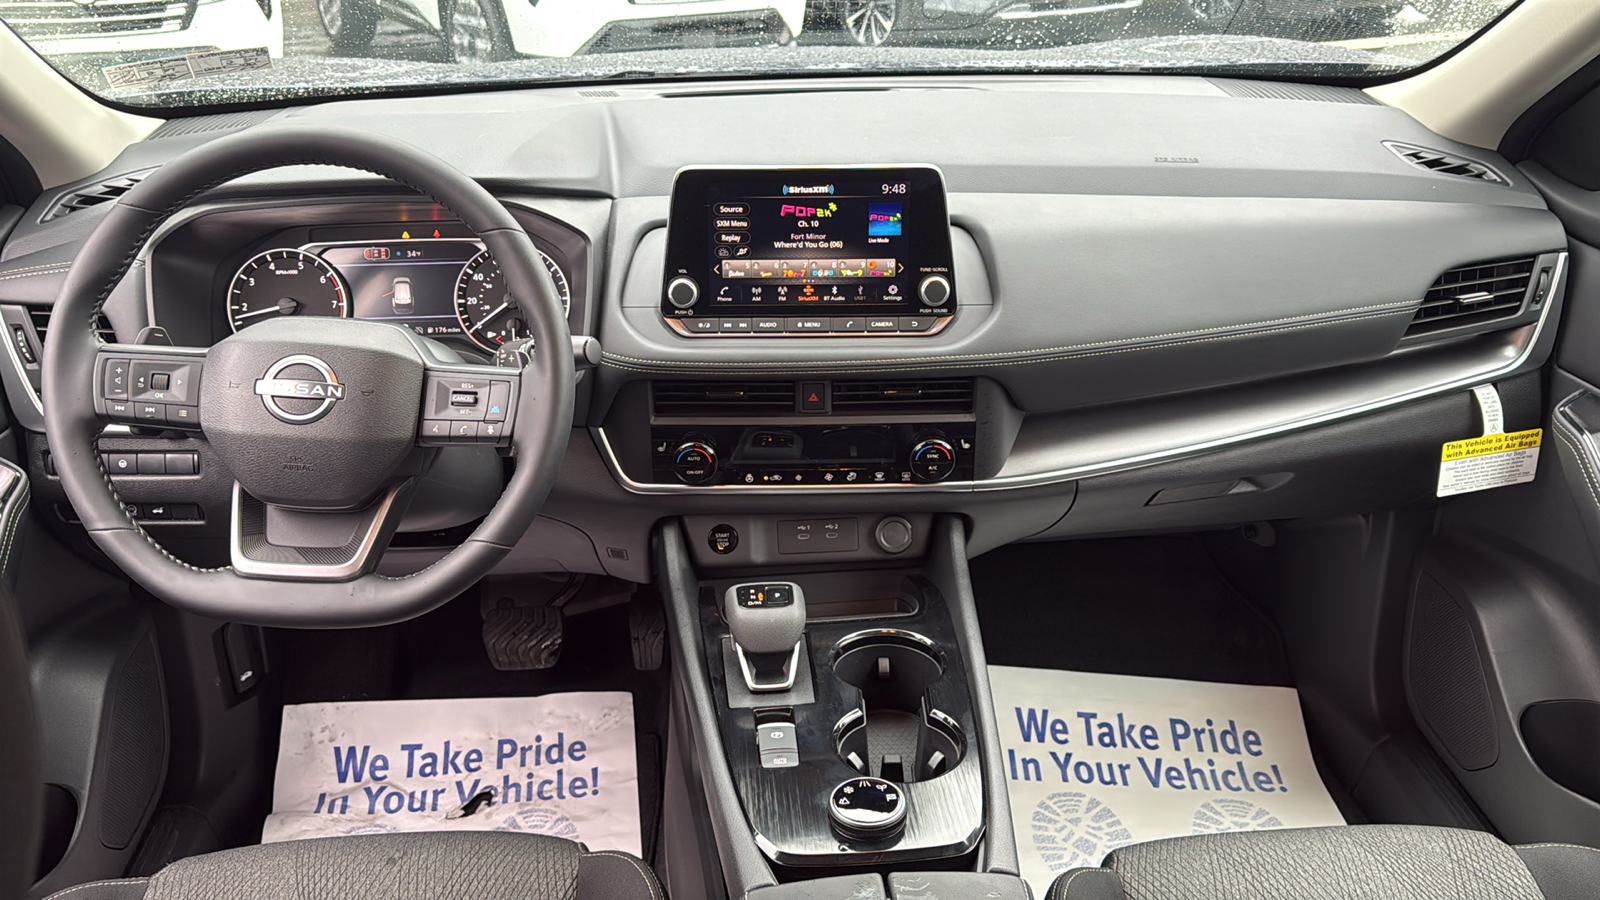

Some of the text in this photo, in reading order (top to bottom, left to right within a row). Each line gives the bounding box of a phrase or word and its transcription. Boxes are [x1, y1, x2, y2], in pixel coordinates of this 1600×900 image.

[882, 184, 906, 194] 9:48
[720, 206, 743, 214] Source
[721, 234, 742, 243] Replay
[830, 241, 843, 249] (06)
[268, 262, 276, 270] 4
[1446, 442, 1462, 450] This
[1465, 438, 1493, 447] Vehicle
[1504, 431, 1539, 442] Equipped
[1446, 450, 1463, 458] with
[1465, 444, 1503, 455] Advanced
[1518, 440, 1537, 448] Bags
[1014, 706, 1262, 756] We Take Pride
[333, 732, 587, 784] We Take Pride
[1007, 748, 1288, 793] In Your Vehicle!
[314, 792, 348, 814] In
[363, 786, 446, 815] Your
